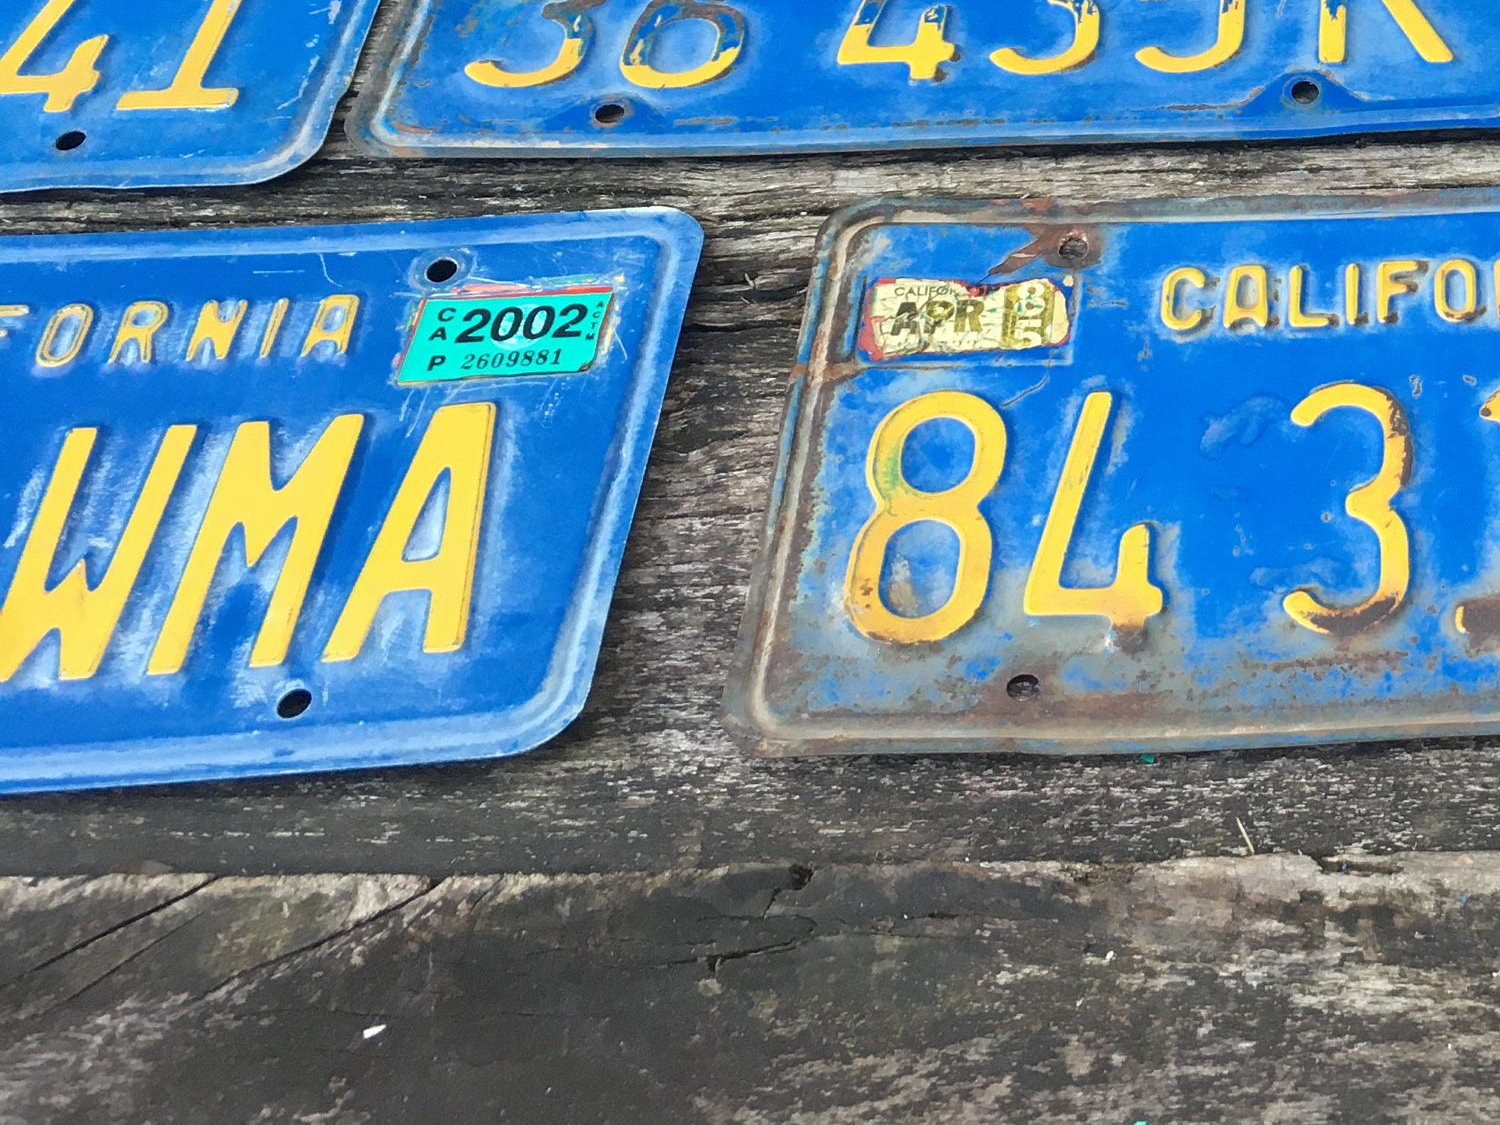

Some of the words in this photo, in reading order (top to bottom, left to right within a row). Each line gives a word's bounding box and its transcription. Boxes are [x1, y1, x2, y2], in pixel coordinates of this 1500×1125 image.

[454, 303, 589, 344] 2002
[891, 300, 985, 336] APR
[461, 348, 563, 370] 2609881
[842, 389, 1165, 645] 84
